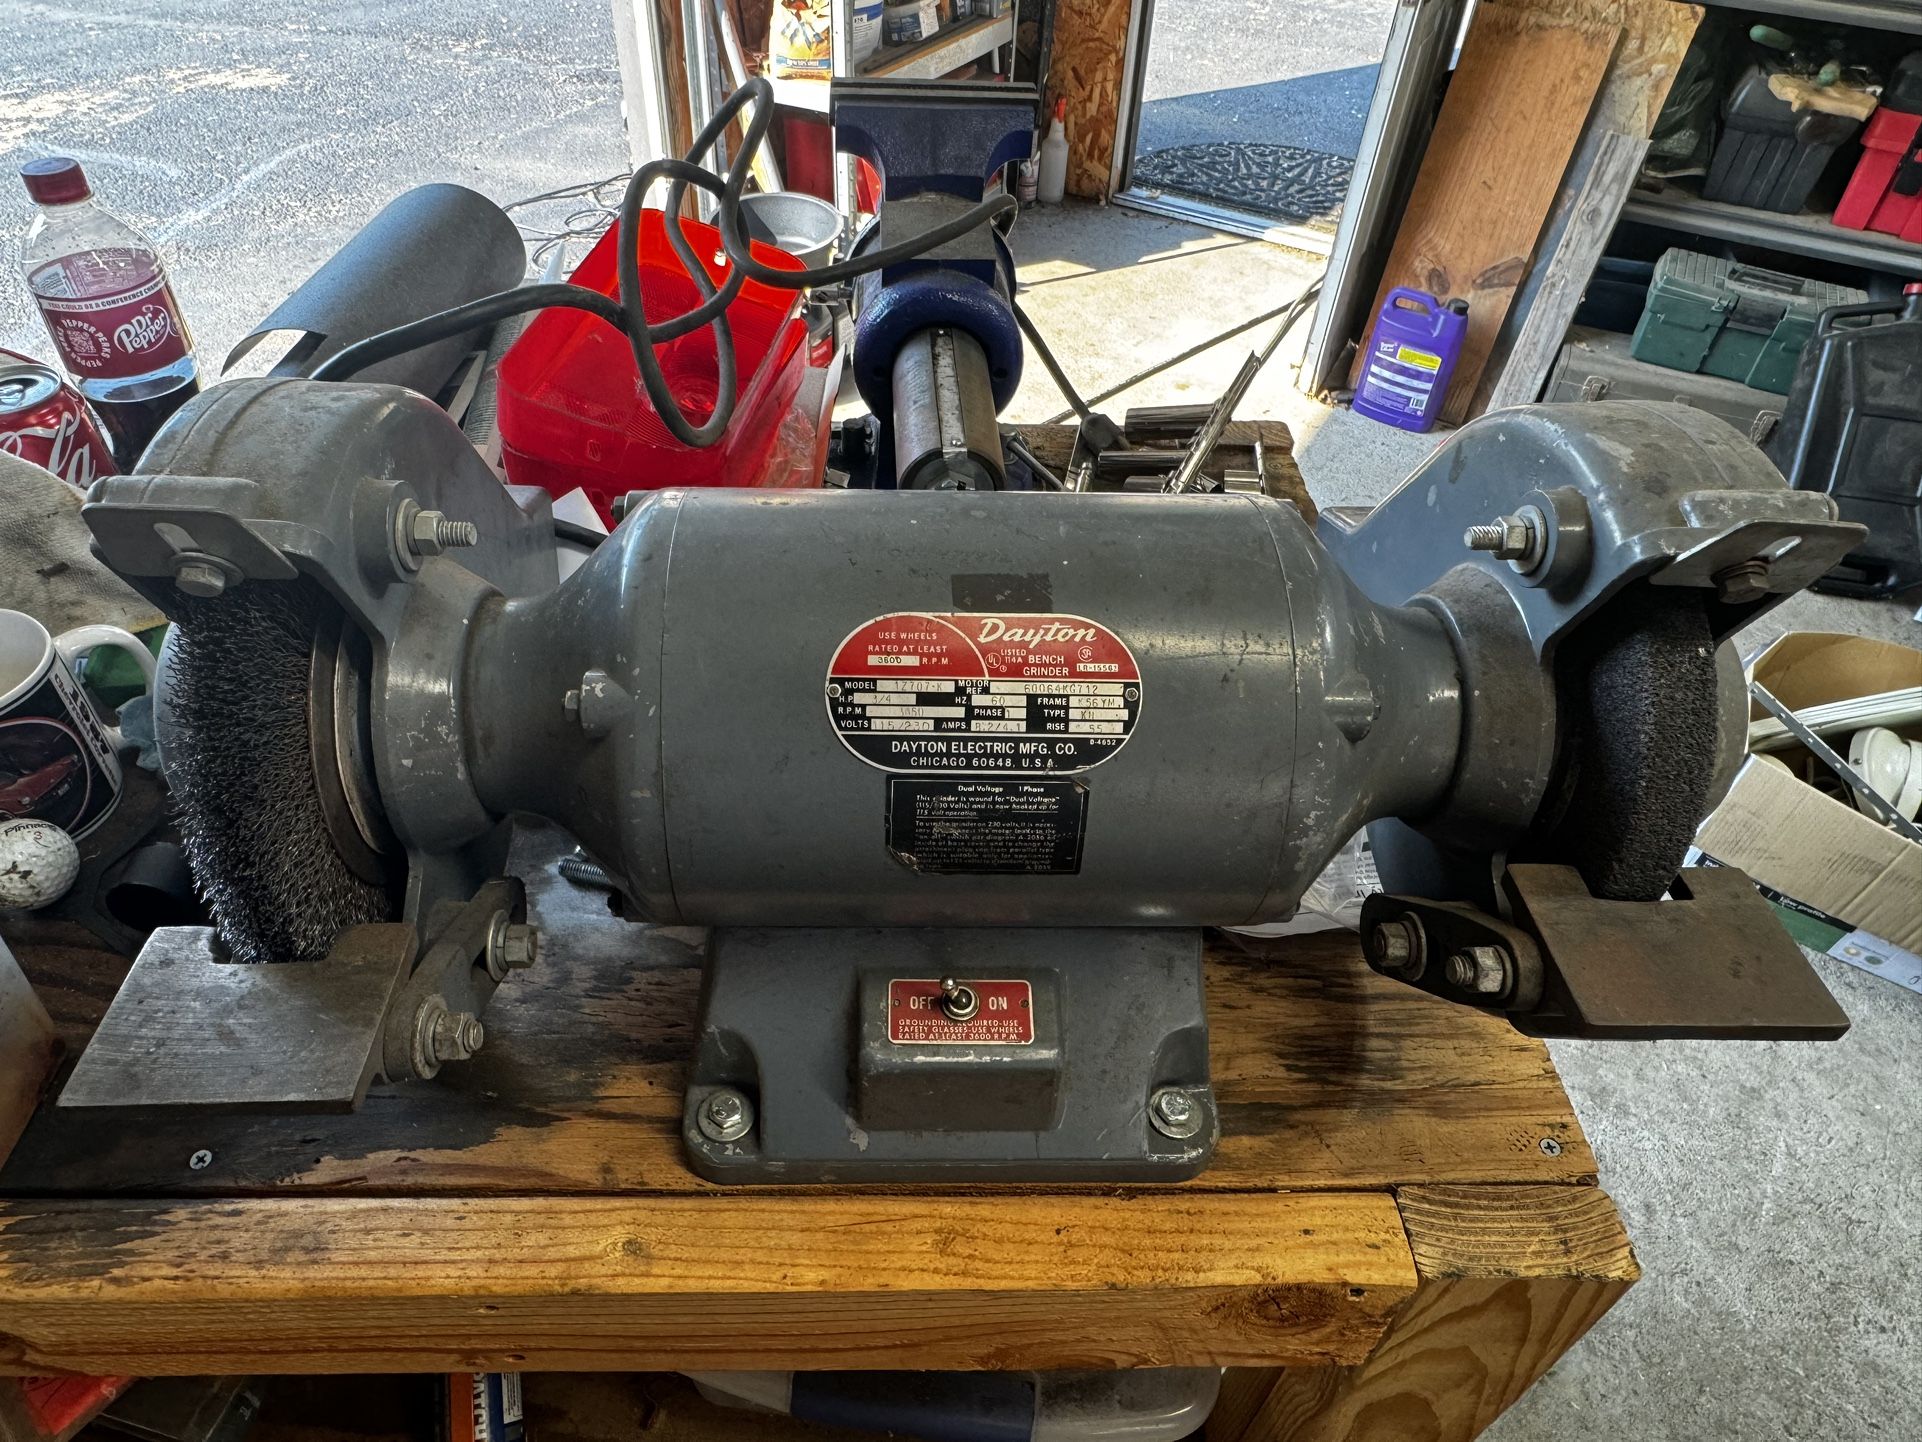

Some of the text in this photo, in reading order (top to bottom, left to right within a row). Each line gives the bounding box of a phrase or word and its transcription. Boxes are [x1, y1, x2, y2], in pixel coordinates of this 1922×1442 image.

[130, 312, 152, 331] Dr
[61, 319, 97, 336] PEPPER
[114, 313, 166, 354] Pepper
[95, 332, 111, 359] PERKS
[879, 632, 938, 641] USE WHEELS
[977, 618, 1098, 649] Dayton
[868, 645, 948, 654] RATED AT LEAST
[1000, 648, 1027, 657] LISTED
[922, 657, 952, 665] R.P.M.
[1028, 655, 1065, 664] BENCH
[1023, 667, 1070, 676] GRINDER
[845, 681, 875, 690] MODEL
[958, 680, 989, 688] MOTOR
[966, 687, 985, 695] REF.
[1037, 698, 1068, 706] FRAME
[1043, 709, 1066, 718] TYPE
[840, 720, 869, 728] VOLTS
[1046, 722, 1066, 731] RISE
[891, 741, 1078, 755] DAYTON ELECTRIC MFG. CO.
[910, 757, 1058, 769] CHICAGO 60648, U.S.A.
[4, 823, 57, 837] Pinnac
[33, 830, 43, 840] 3
[988, 996, 1008, 1010] ON
[899, 1026, 1023, 1034] SAFETY GLASSES-USE WHEELS
[940, 1033, 966, 1041] LEAST
[969, 1033, 990, 1041] 3600
